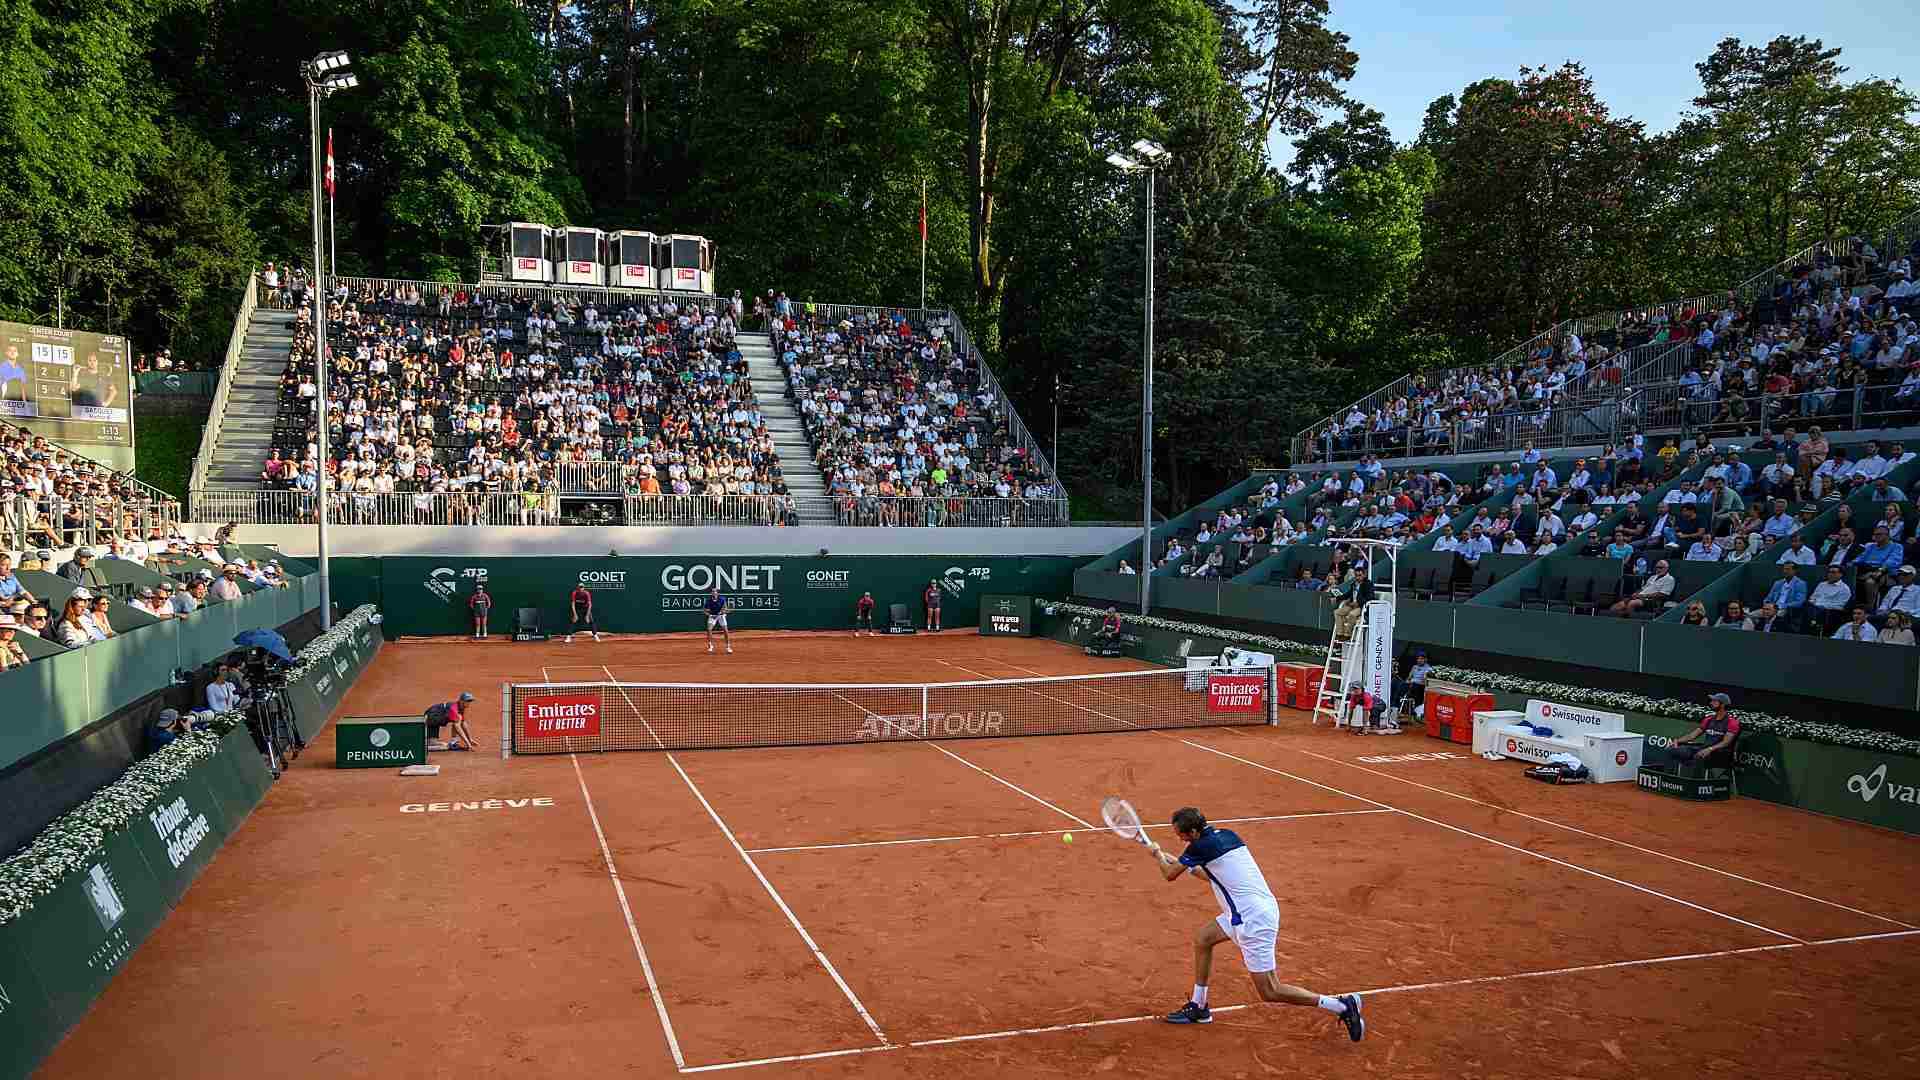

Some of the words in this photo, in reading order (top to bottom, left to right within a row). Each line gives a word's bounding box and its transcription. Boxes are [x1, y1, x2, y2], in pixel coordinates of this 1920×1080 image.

[37, 346, 48, 358] 15
[57, 348, 68, 360] 15
[41, 384, 48, 394] 5
[579, 571, 627, 582] GONET
[660, 564, 781, 592] GONET
[806, 570, 849, 581] GONET
[968, 567, 991, 577] ATP
[751, 597, 781, 608] 1845
[993, 622, 1010, 633] 146
[1375, 636, 1383, 670] GENEVA
[1211, 681, 1261, 696] Emirates
[528, 702, 596, 719] Emirates
[1551, 707, 1601, 726] Swissquote
[538, 719, 554, 732] FLY
[554, 717, 586, 731] BETTER
[927, 711, 1003, 737] TOUR
[347, 749, 415, 762] PENINSULA
[1638, 772, 1658, 789] m3
[150, 796, 189, 841] Tribune
